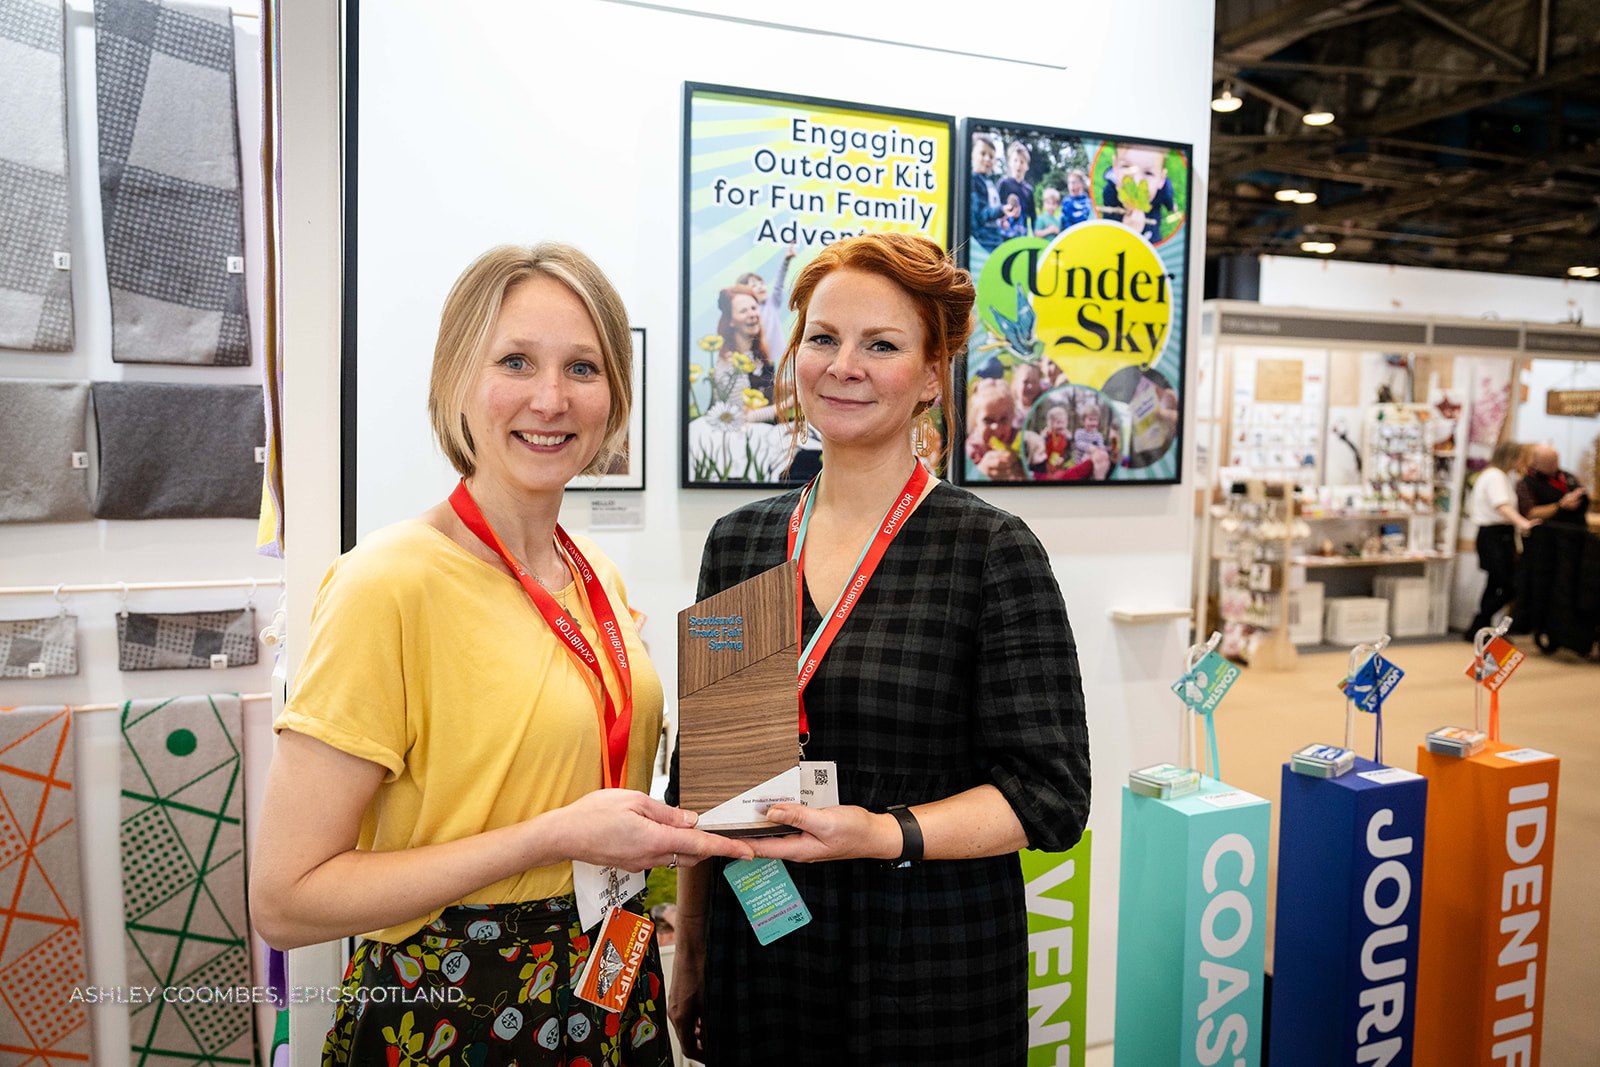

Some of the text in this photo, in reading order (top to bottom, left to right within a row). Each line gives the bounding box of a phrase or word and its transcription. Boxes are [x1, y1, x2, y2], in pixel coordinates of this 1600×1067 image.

[792, 118, 934, 164] Engaging
[754, 149, 935, 190] Outdoor Kit
[714, 179, 933, 229] for Fun Family
[1002, 247, 1175, 304] Under
[1054, 303, 1167, 369] Sky
[884, 493, 914, 535] EXHIBITOR
[564, 540, 593, 584] EXHIBITOR
[689, 614, 743, 626] Scotland's
[836, 574, 867, 620] EXHIBITOR
[554, 615, 595, 664] EXHIBITOR
[603, 620, 627, 669] EXHIBITOR
[688, 627, 743, 638] Trade Fair
[709, 639, 743, 652] Spring
[1202, 667, 1237, 711] COASTAL
[1366, 669, 1400, 711] JOUREY
[1491, 782, 1550, 1067] IDENTIF
[615, 922, 651, 1007] IDENTIFY
[1195, 833, 1256, 1067] COAS
